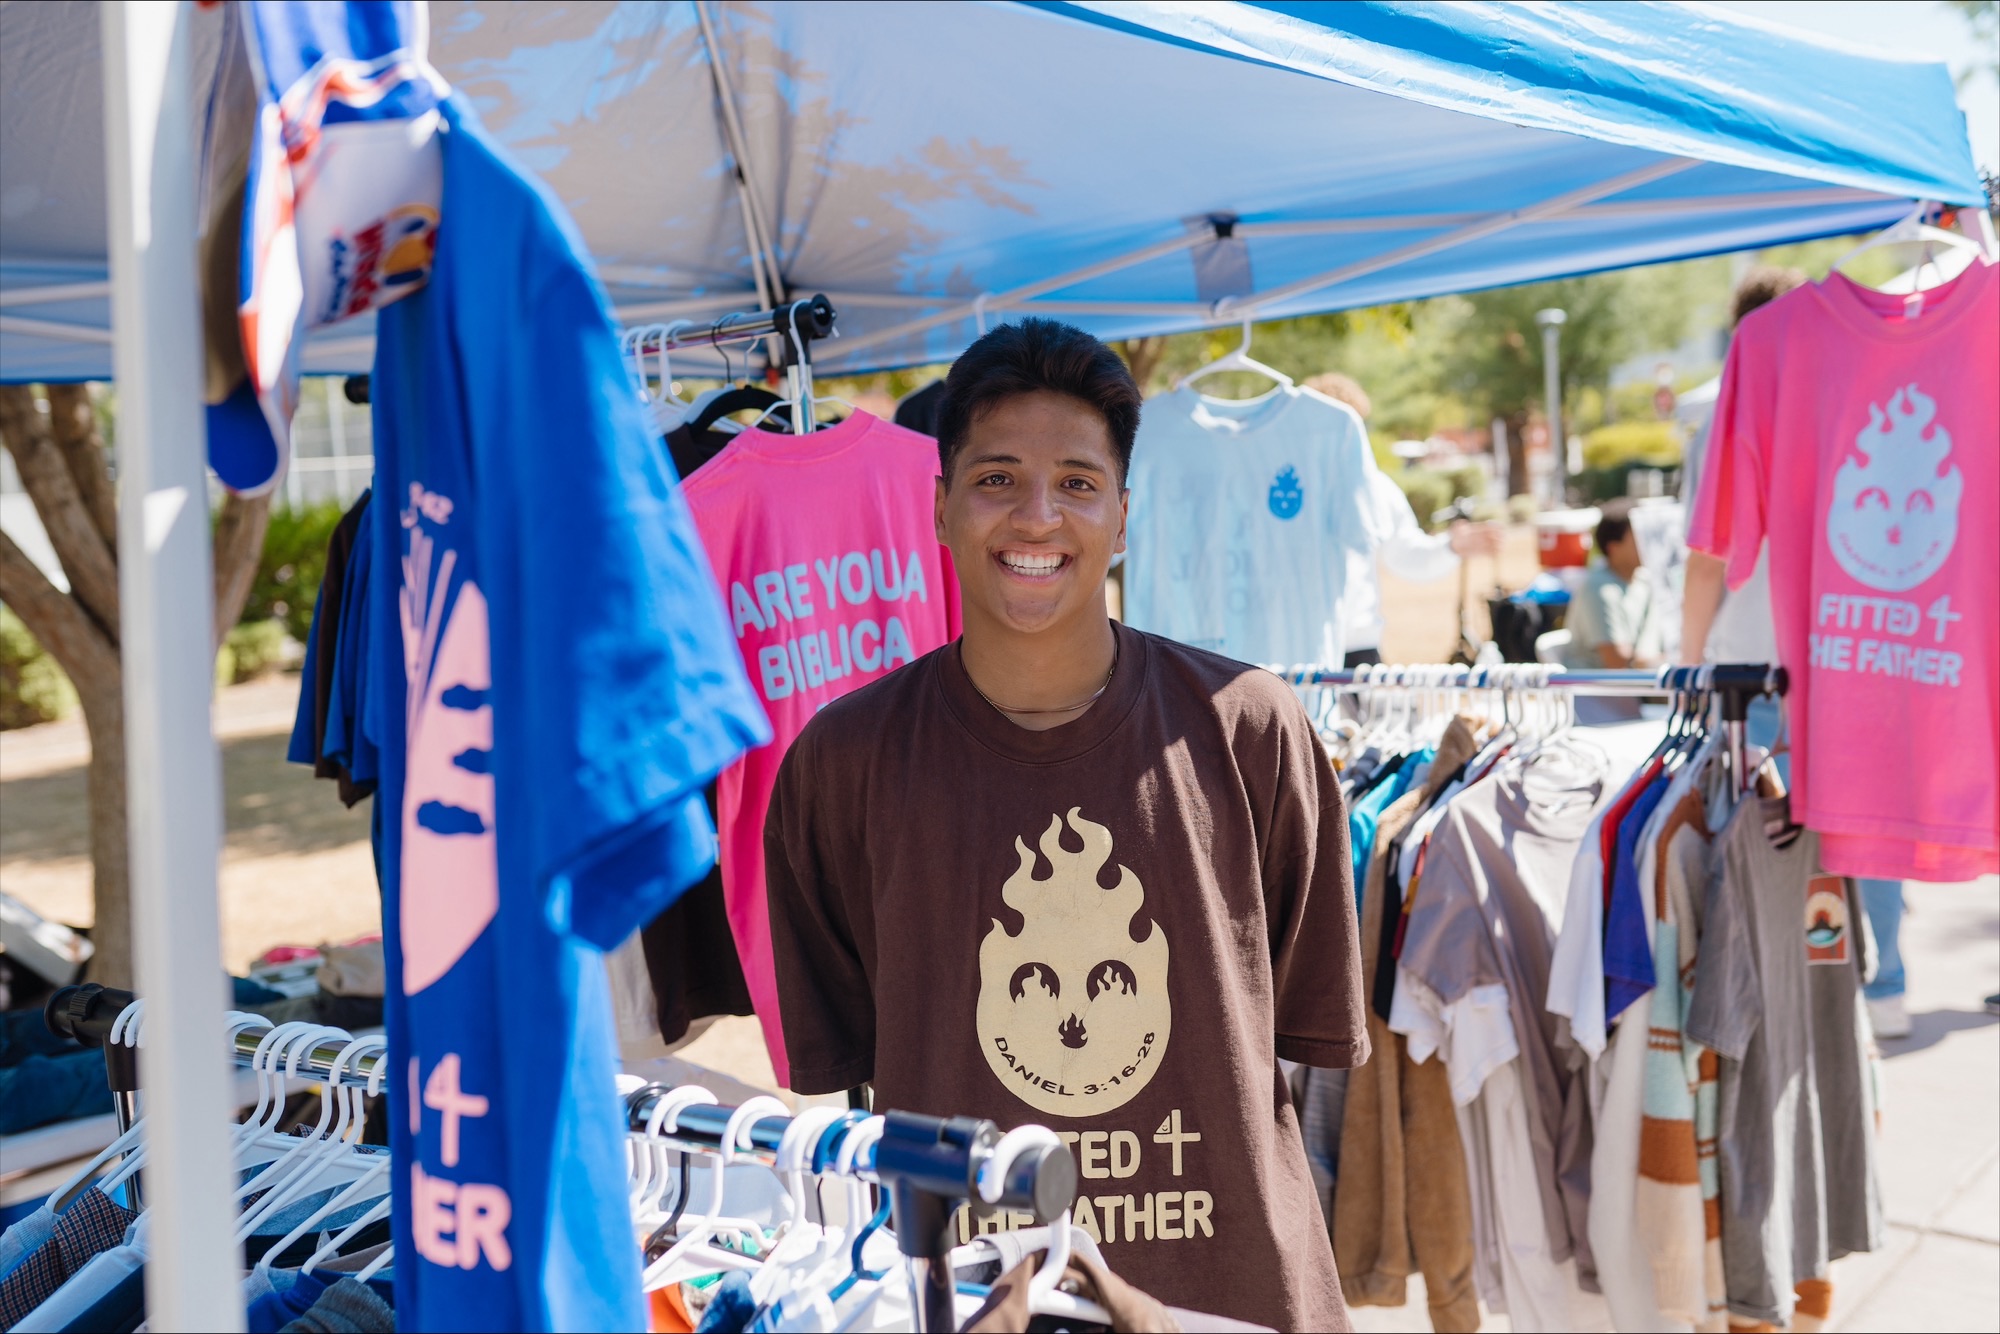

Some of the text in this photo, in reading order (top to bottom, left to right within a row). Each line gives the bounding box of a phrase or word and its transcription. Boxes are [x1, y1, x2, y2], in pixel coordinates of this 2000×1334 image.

[731, 548, 928, 638] ARE YOU A
[1818, 593, 1963, 643] FITTED 4
[1809, 633, 1964, 688] HE FATHER
[994, 1031, 1156, 1097] DANIEL 3:16-28
[423, 1053, 490, 1168] 4
[1153, 1108, 1202, 1177] 4
[1067, 1190, 1215, 1244] ATHER
